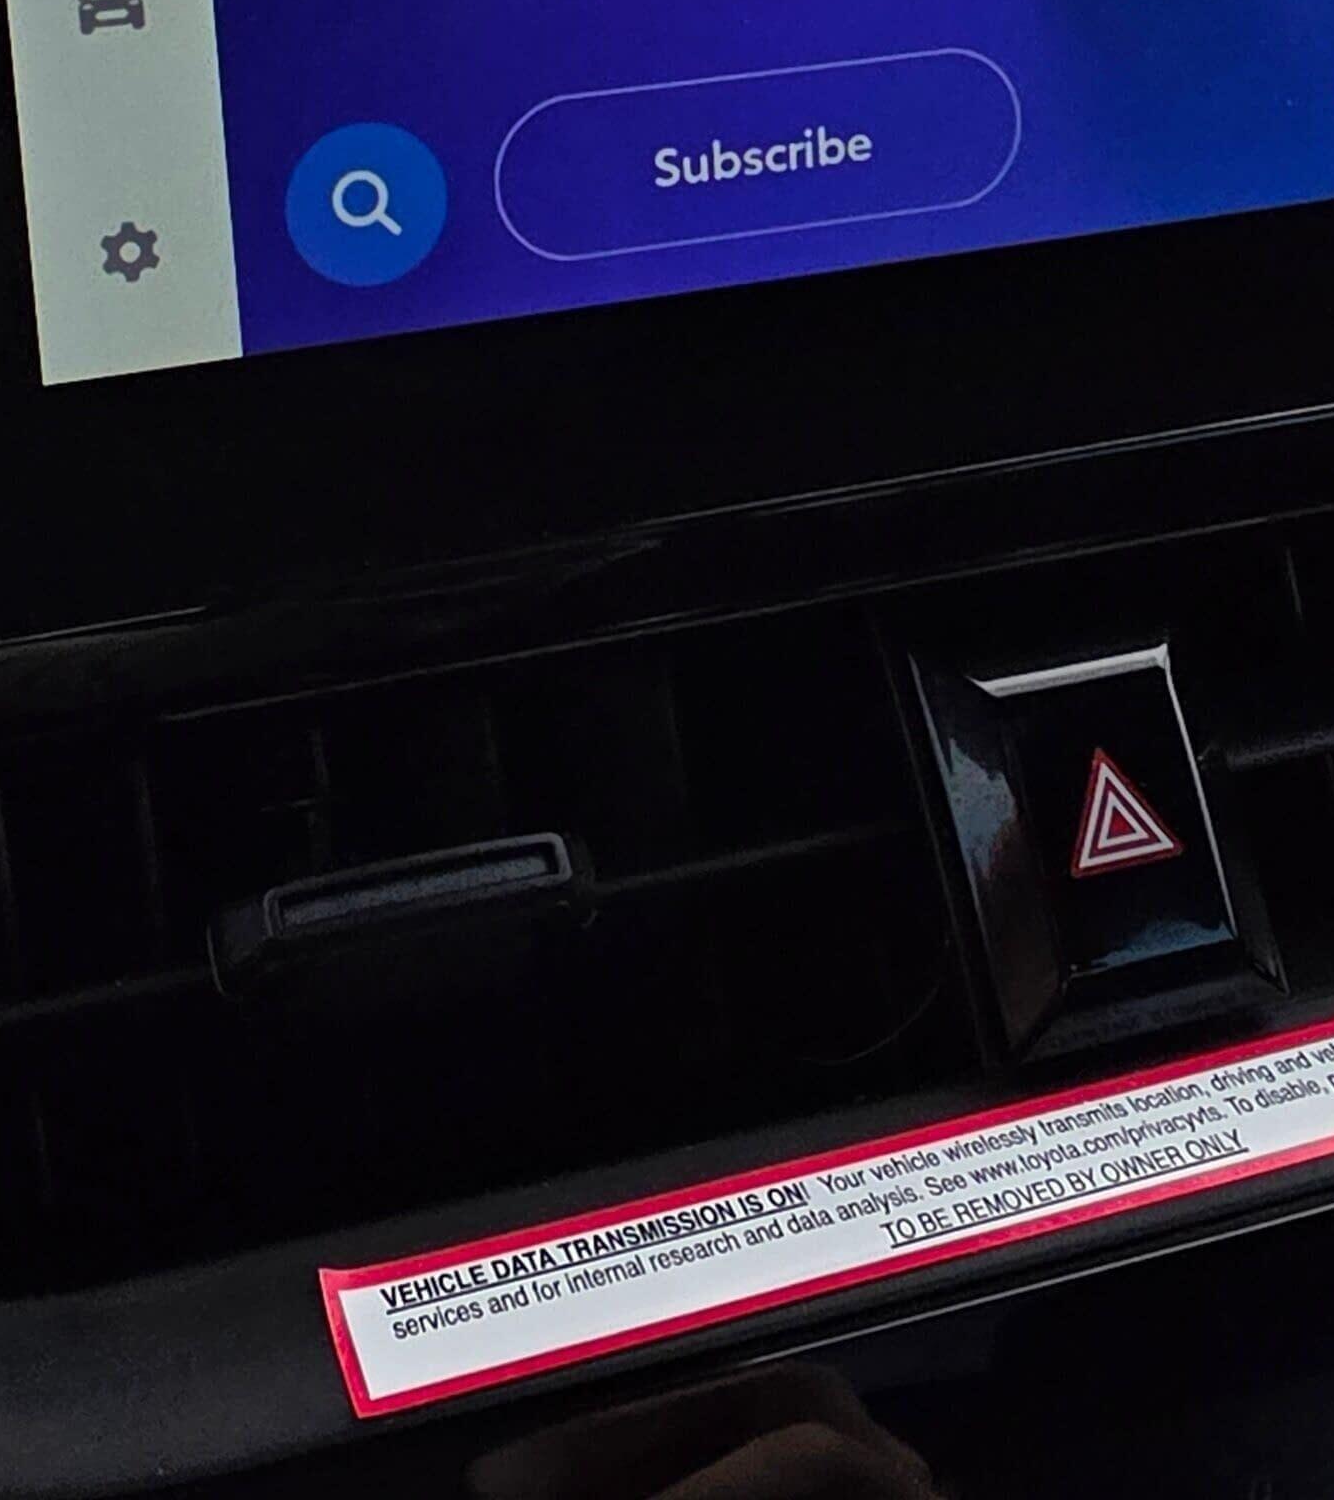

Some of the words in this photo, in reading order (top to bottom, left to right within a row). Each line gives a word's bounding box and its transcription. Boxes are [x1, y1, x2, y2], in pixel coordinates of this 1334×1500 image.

[652, 126, 874, 189] Subscribe
[380, 1265, 488, 1309] VEHICLE
[491, 1249, 556, 1281] DATA
[557, 1201, 736, 1262] TRANSMISSION
[738, 1194, 764, 1216] IS
[767, 1182, 810, 1208] ON!
[817, 1170, 866, 1194] Your
[869, 1151, 941, 1181] vehicle
[942, 1125, 1038, 1162] wirelessly
[1038, 1100, 1128, 1137] transmits
[1127, 1083, 1211, 1114] location,
[1210, 1065, 1276, 1093] driving
[1274, 1051, 1312, 1075] and
[392, 1302, 484, 1340] services
[489, 1284, 530, 1315] and
[531, 1278, 562, 1303] for
[565, 1255, 646, 1294] internal
[648, 1232, 741, 1273] research
[743, 1219, 785, 1247] and
[787, 1209, 833, 1235] data
[836, 1185, 924, 1221] analysis.
[924, 1174, 967, 1197] See
[969, 1106, 1227, 1184] www.toyota.com/privacyvts.
[1224, 1095, 1255, 1116] To
[1255, 1078, 1330, 1109] disable,
[880, 1217, 917, 1245] TO
[918, 1207, 953, 1235] BE
[952, 1177, 1065, 1225] REMOVED
[1065, 1167, 1098, 1193] BY
[1101, 1149, 1186, 1183] OWNER
[1186, 1128, 1245, 1160] ONLY
